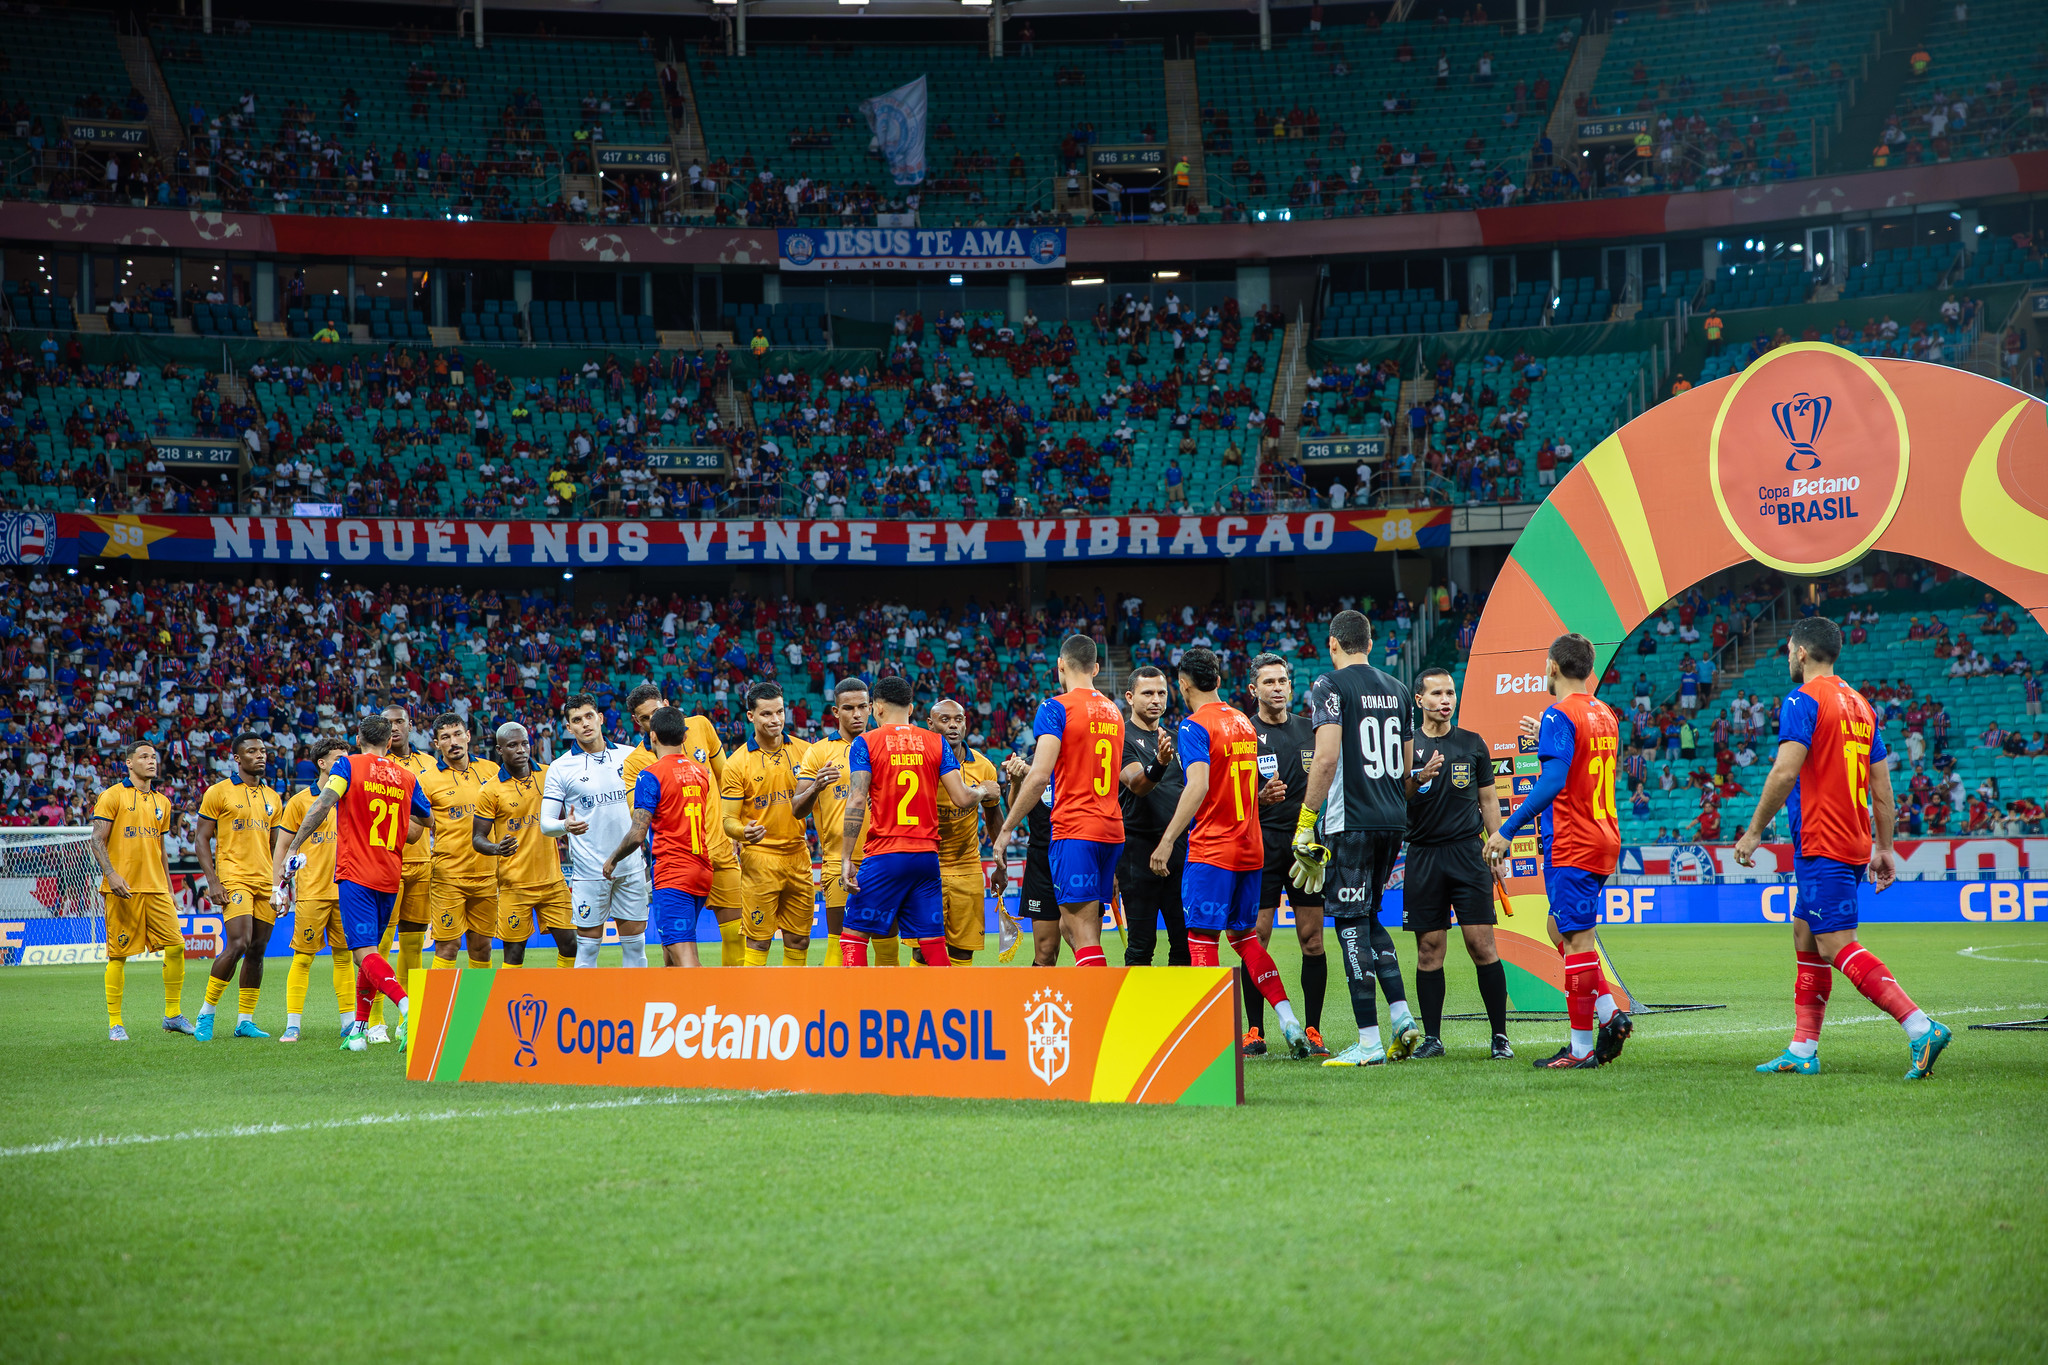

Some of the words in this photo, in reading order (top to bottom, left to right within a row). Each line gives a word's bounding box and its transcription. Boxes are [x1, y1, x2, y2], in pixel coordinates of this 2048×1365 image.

[74, 127, 95, 138] 418
[122, 130, 143, 141] 417
[1583, 125, 1603, 135] 415
[602, 152, 622, 162] 417
[646, 153, 666, 163] 416
[1098, 153, 1118, 163] 416
[1141, 151, 1160, 162] 415
[820, 229, 911, 257] JESUS
[916, 231, 952, 257] TE
[959, 230, 1026, 257] AMA
[859, 260, 908, 270] AMOR
[917, 261, 925, 269] E
[935, 260, 1026, 270] FUTEBOL!
[157, 447, 180, 459] 218
[210, 449, 232, 461] 217
[1308, 445, 1330, 457] 216
[1357, 443, 1379, 455] 214
[648, 454, 669, 466] 217
[696, 455, 718, 466] 216
[1759, 486, 1790, 501] Copa
[1792, 475, 1861, 497] Betano
[1760, 503, 1776, 516] do
[1777, 496, 1859, 526] BRASIL
[113, 523, 144, 547] 59
[1381, 518, 1413, 542] 88
[210, 517, 512, 563] NINGUÉM
[530, 522, 649, 563] NOS
[678, 521, 878, 562] VENCE
[906, 522, 989, 562] EM
[1017, 513, 1336, 559] VIBRAÇÃO
[1361, 695, 1399, 709] RONALDO
[1090, 721, 1097, 734] G.
[1098, 722, 1119, 736] XAVIER
[1360, 716, 1405, 779] 96
[1494, 743, 1516, 751] Betano
[890, 753, 924, 766] GILBERTO
[1094, 738, 1113, 796] 3
[1259, 756, 1276, 764] FIFA
[1491, 759, 1512, 774] 7K
[364, 780, 386, 795] RAMOS
[1230, 760, 1258, 821] 17
[897, 769, 919, 826] 2
[368, 798, 400, 851] 21
[684, 803, 703, 855] 11
[1338, 882, 1366, 903] axi
[1596, 888, 1656, 923] BF
[1959, 883, 2048, 921] CBF
[184, 937, 214, 951] etano
[556, 1007, 634, 1065] Copa
[638, 1001, 800, 1061] Betano
[804, 1009, 850, 1059] do
[859, 1008, 1007, 1062] BRASIL
[1040, 1036, 1057, 1046] CBF
